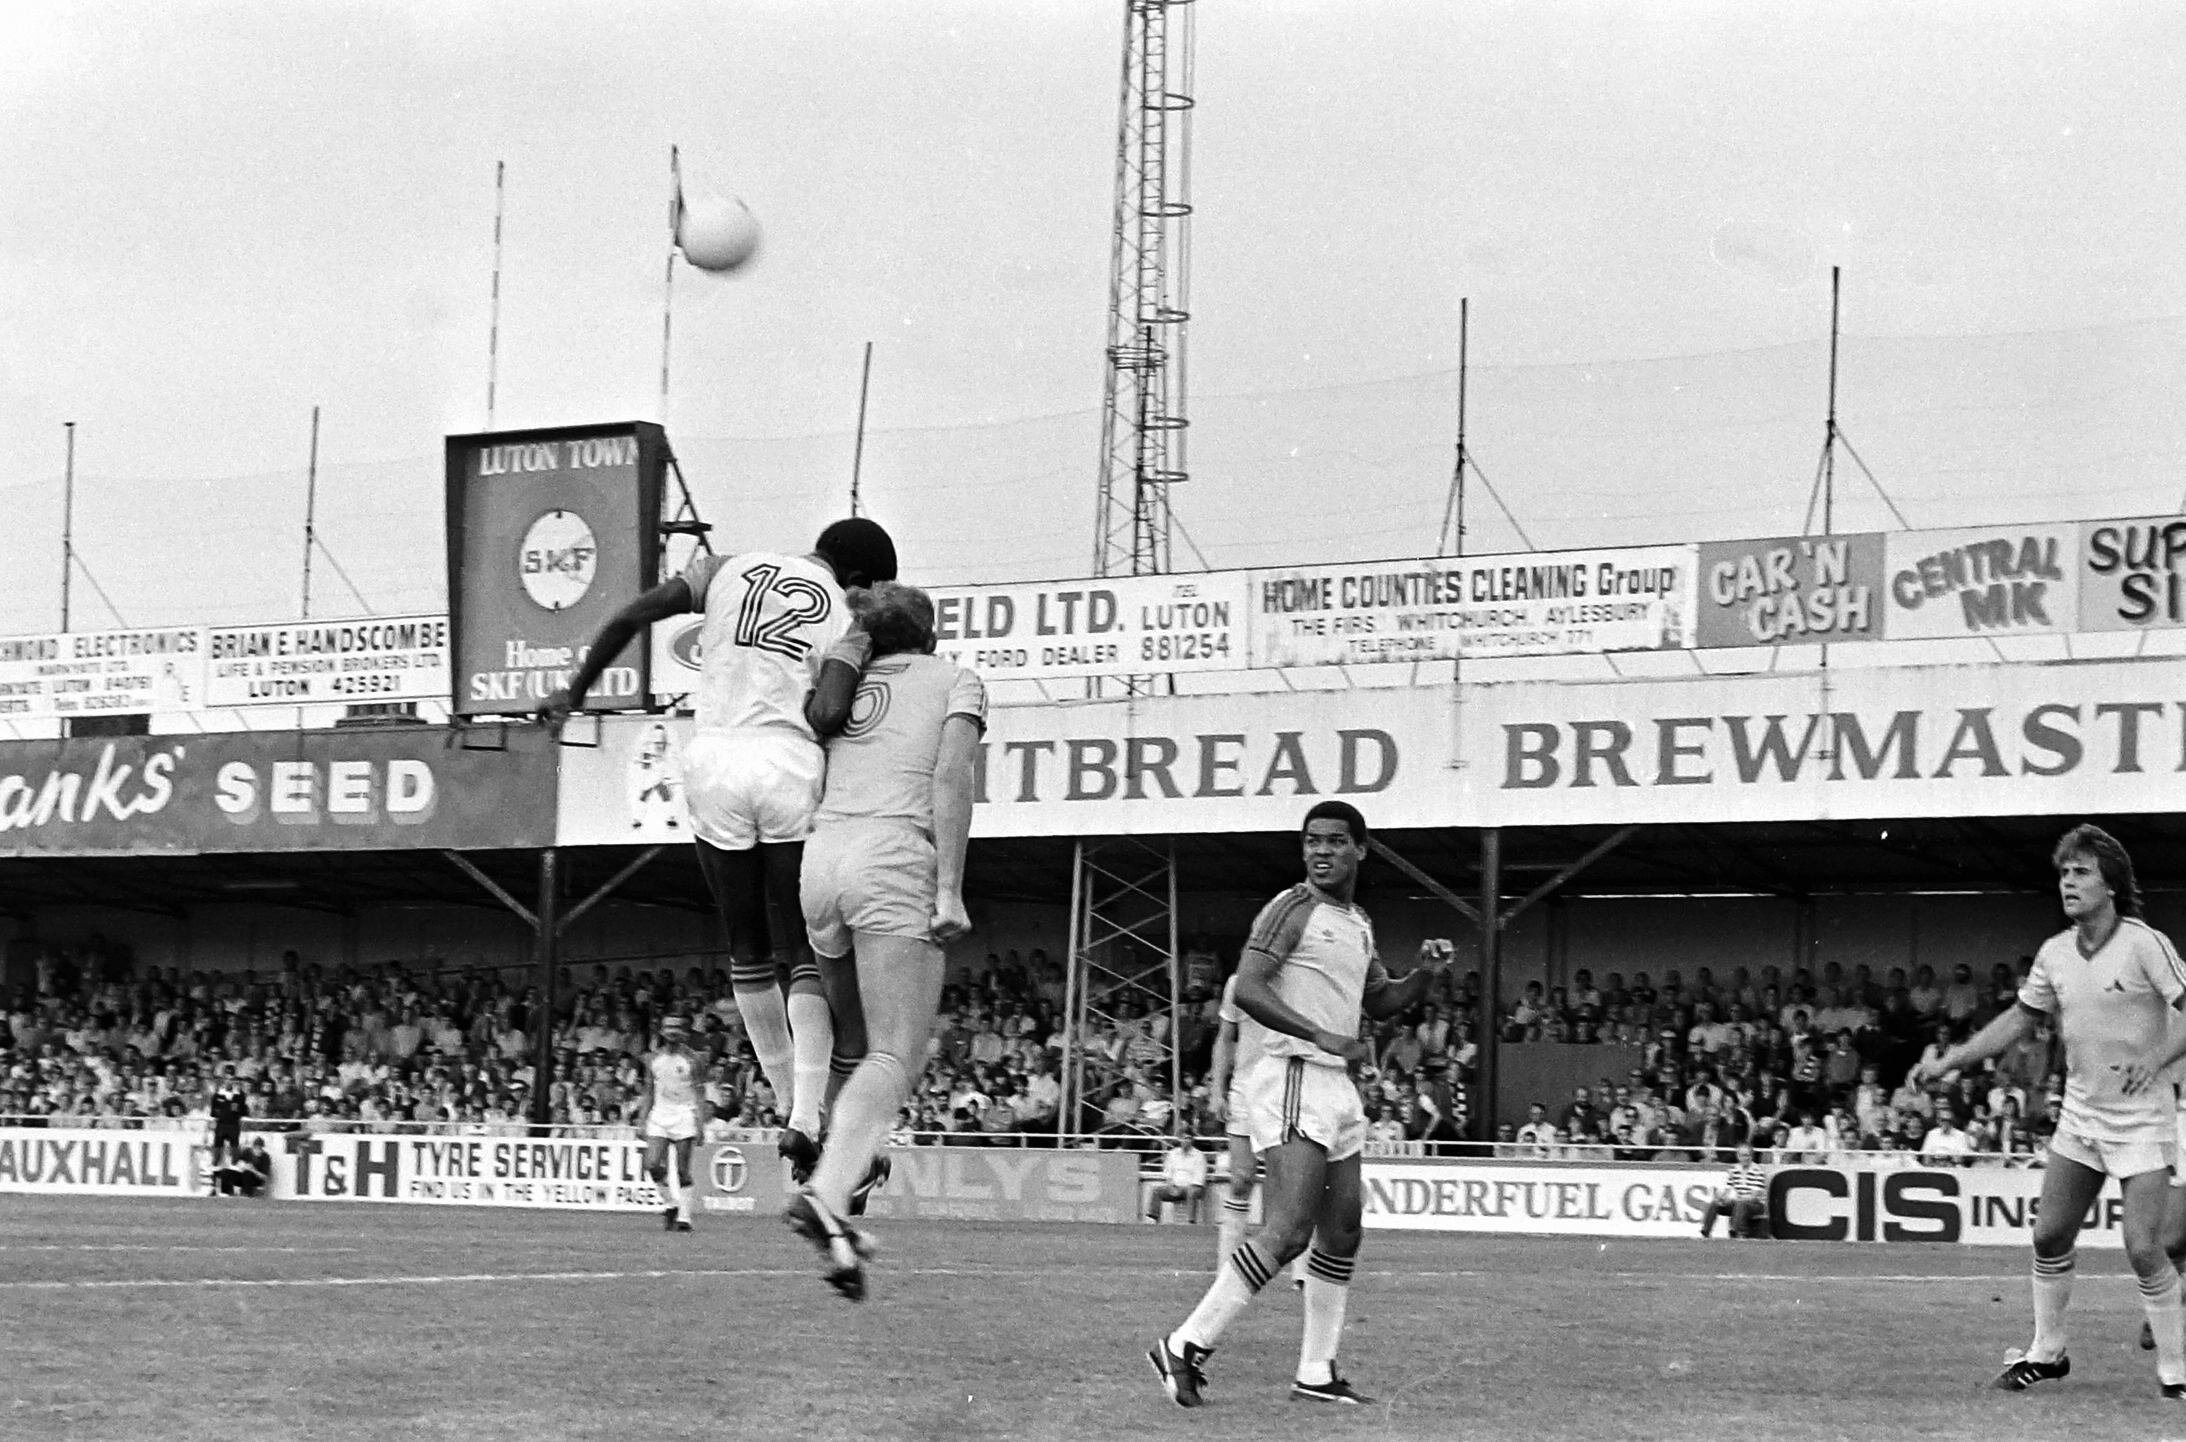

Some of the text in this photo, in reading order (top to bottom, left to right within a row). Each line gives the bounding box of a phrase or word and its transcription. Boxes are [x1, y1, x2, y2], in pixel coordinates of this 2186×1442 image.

[480, 442, 559, 476] LUTON
[525, 548, 594, 573] SKF
[1710, 546, 1797, 607] CAR
[1892, 536, 2062, 609] CENTRAL
[1263, 562, 1674, 614] HOME COUNTIES CLEANING Group
[1959, 582, 2052, 632] MK
[735, 563, 831, 662] 12
[936, 589, 1125, 640] ELD LTD.
[1142, 601, 1230, 630] LUTON
[1292, 618, 1326, 637] THE
[1545, 602, 1649, 625] AYLESBURY
[1749, 585, 1871, 642] CASH
[74, 631, 197, 659] ELECTRONICS
[212, 633, 270, 659] BRIAN
[295, 622, 445, 654] HANDSCOMBE
[975, 648, 1029, 668] FORD
[1042, 643, 1119, 666] DEALER
[1141, 633, 1230, 661] 881254
[1349, 636, 1436, 655] TELEPHONE
[249, 679, 310, 698] LUTON
[974, 700, 2186, 803] ITBREAD BREWMAST
[214, 759, 436, 817] SEED
[0, 1139, 179, 1187] AUXHALL
[412, 1141, 649, 1182] TYRE SERVICE LT
[887, 1151, 1100, 1202] NLYS
[502, 1182, 534, 1203] THE
[1365, 1177, 1612, 1221] NDERFUEL
[1769, 1168, 1961, 1243] CIS
